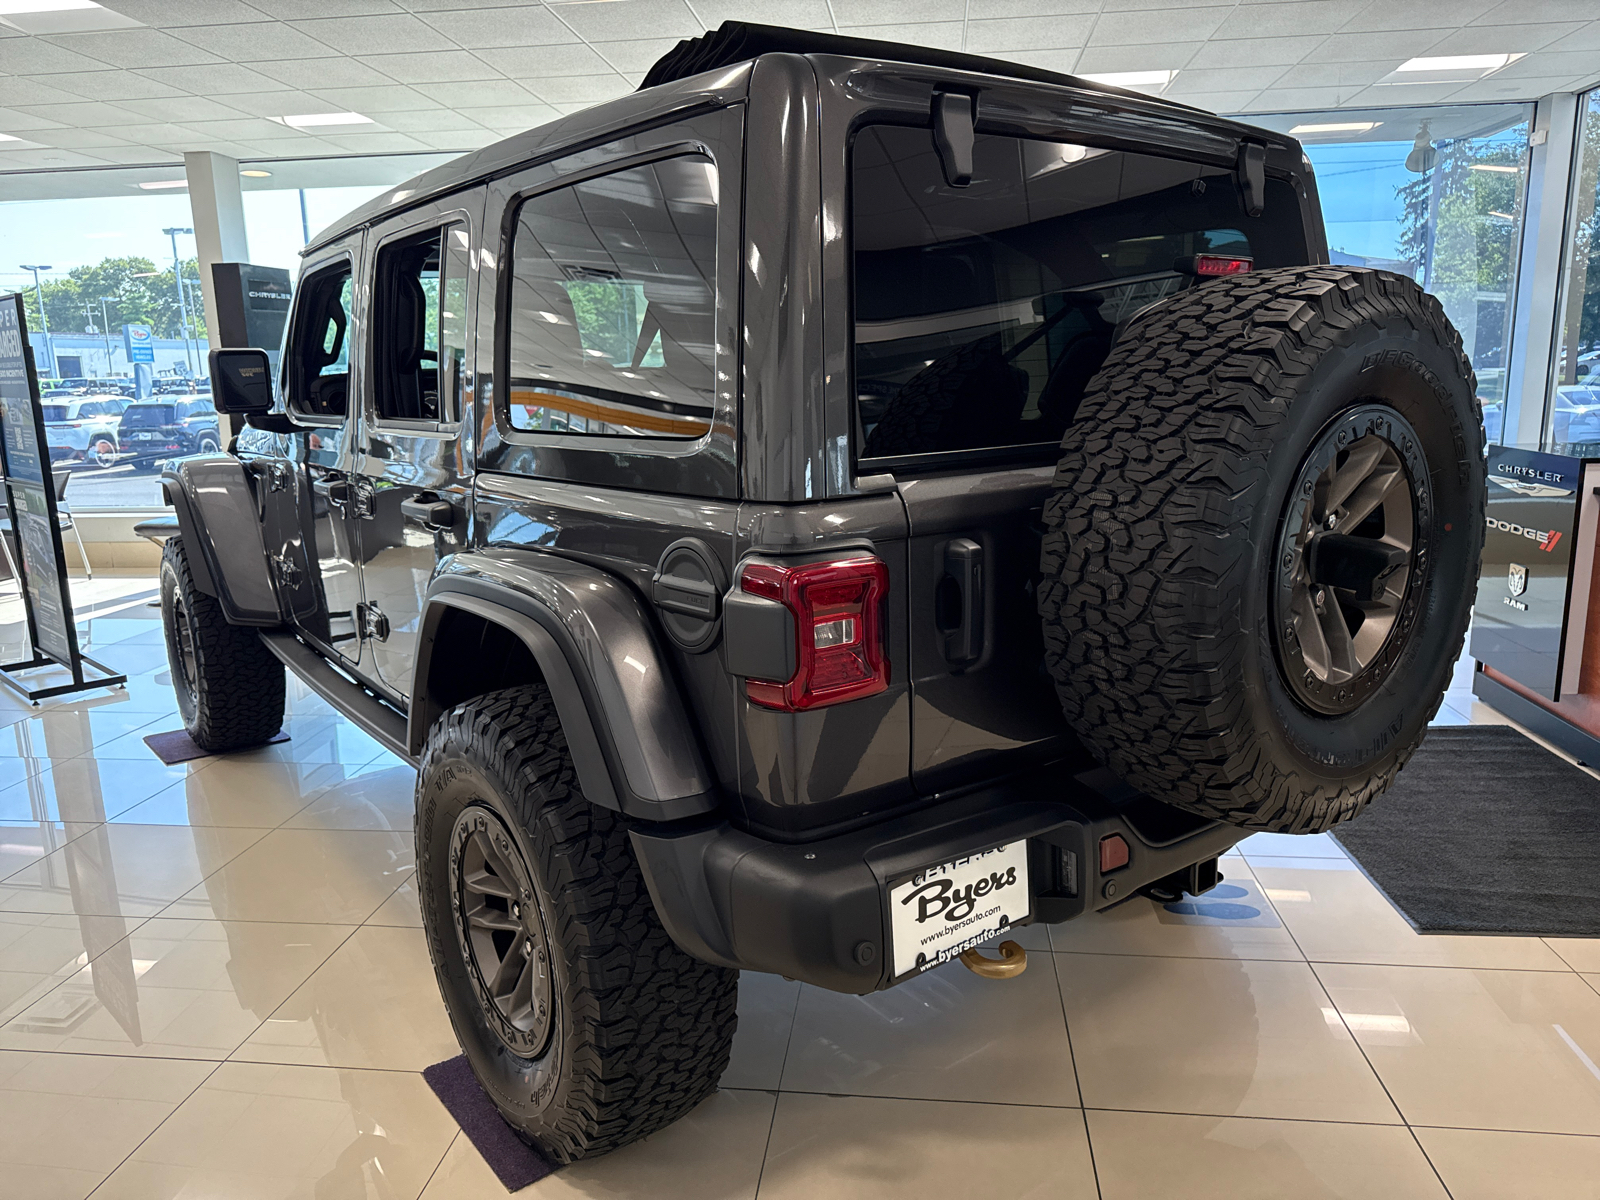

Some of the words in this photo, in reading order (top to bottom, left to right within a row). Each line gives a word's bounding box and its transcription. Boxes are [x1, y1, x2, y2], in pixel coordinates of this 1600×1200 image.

[249, 291, 292, 300] CHRYSLER
[1497, 463, 1562, 483] CHRYSLER
[1485, 517, 1550, 544] DODGE
[1503, 597, 1526, 612] RAM
[901, 866, 1017, 924] Byers
[920, 905, 1001, 946] www.byersauto.com
[919, 925, 1011, 972] www.byersauto.com
